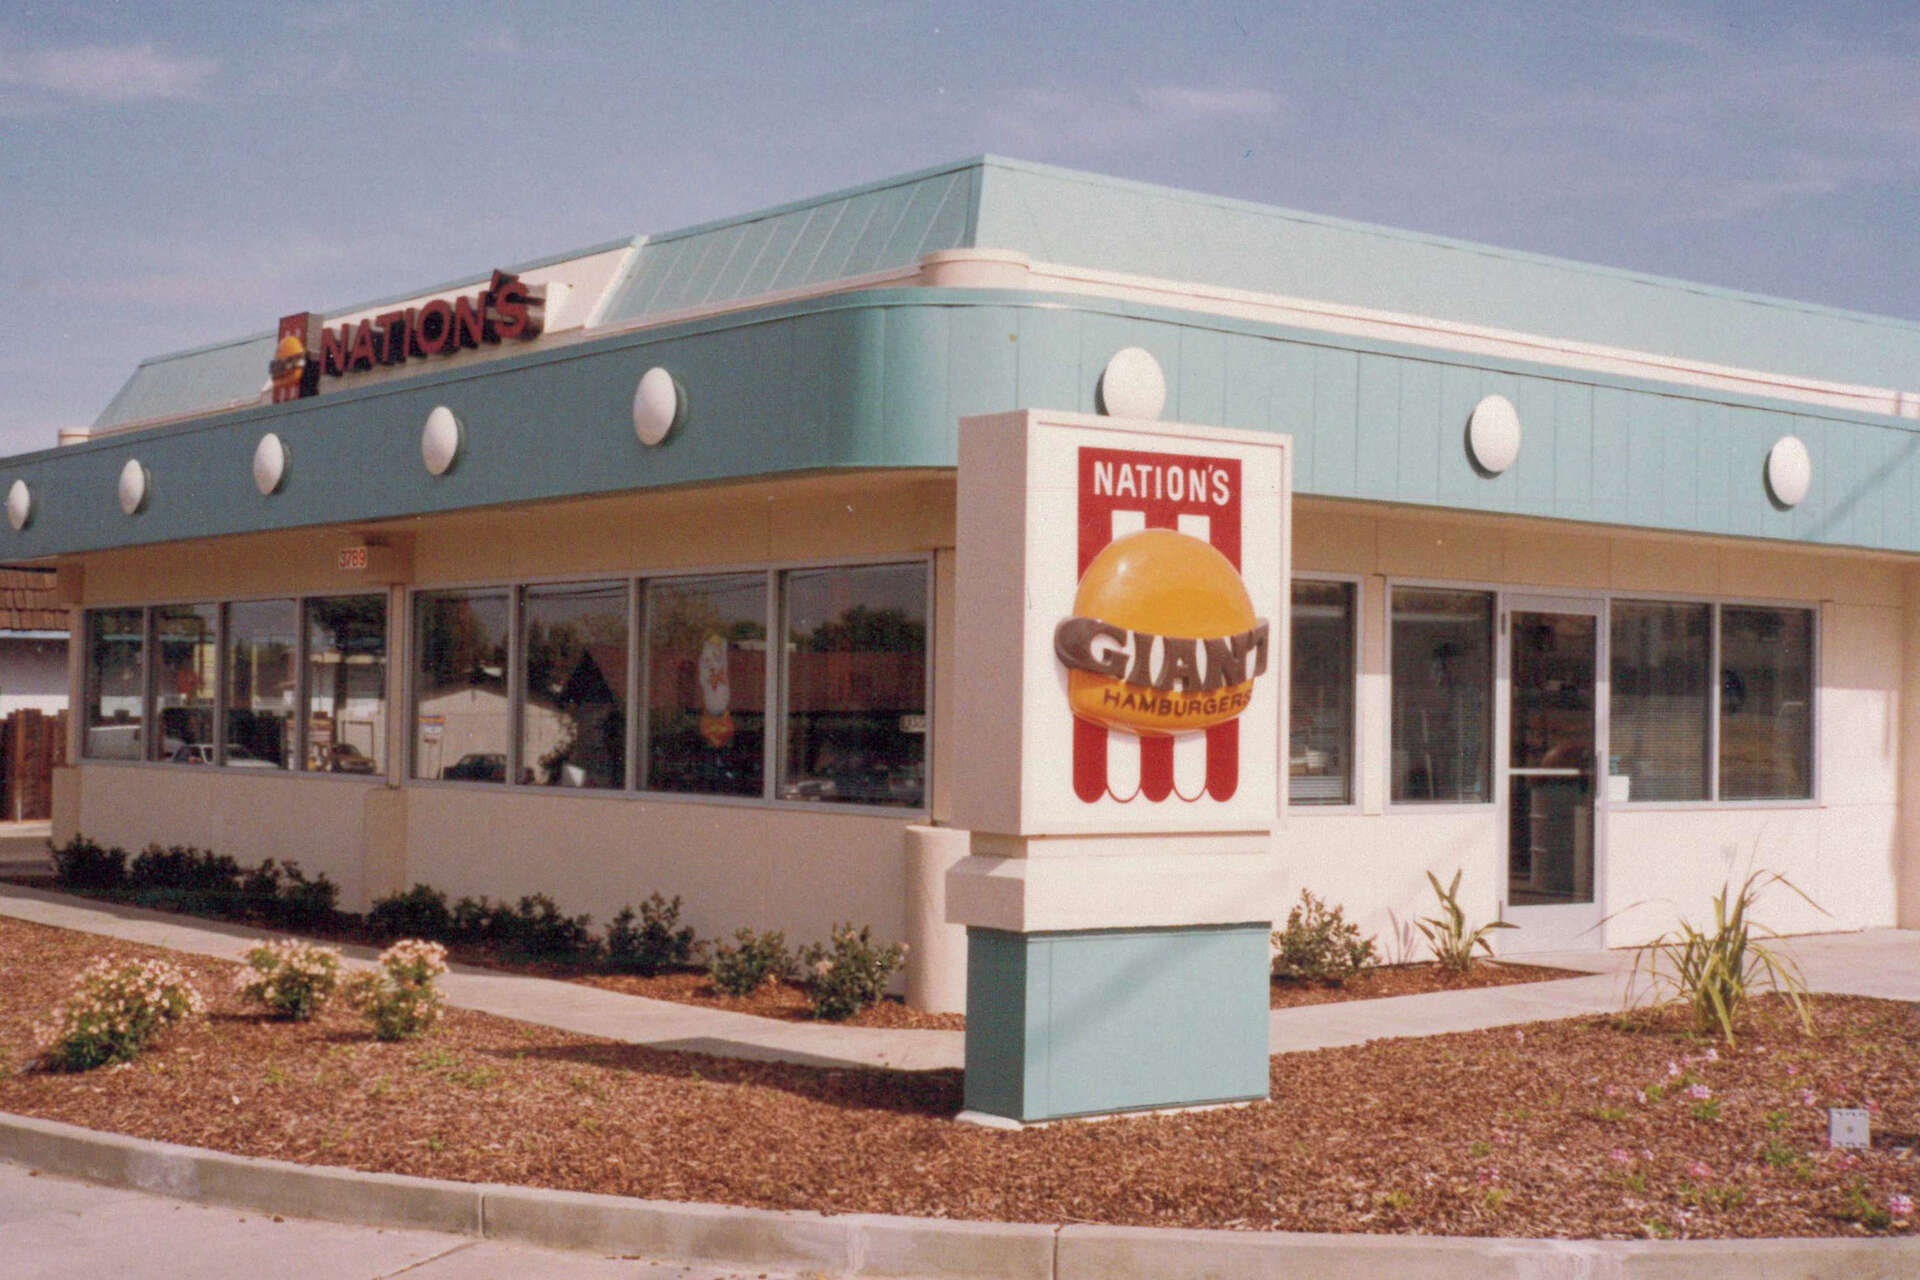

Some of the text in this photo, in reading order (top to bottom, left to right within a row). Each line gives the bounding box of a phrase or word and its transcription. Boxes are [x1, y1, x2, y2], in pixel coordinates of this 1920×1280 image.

[319, 269, 530, 375] NATION'S
[1094, 461, 1230, 506] NATION'S
[1054, 617, 1269, 692] GIANT
